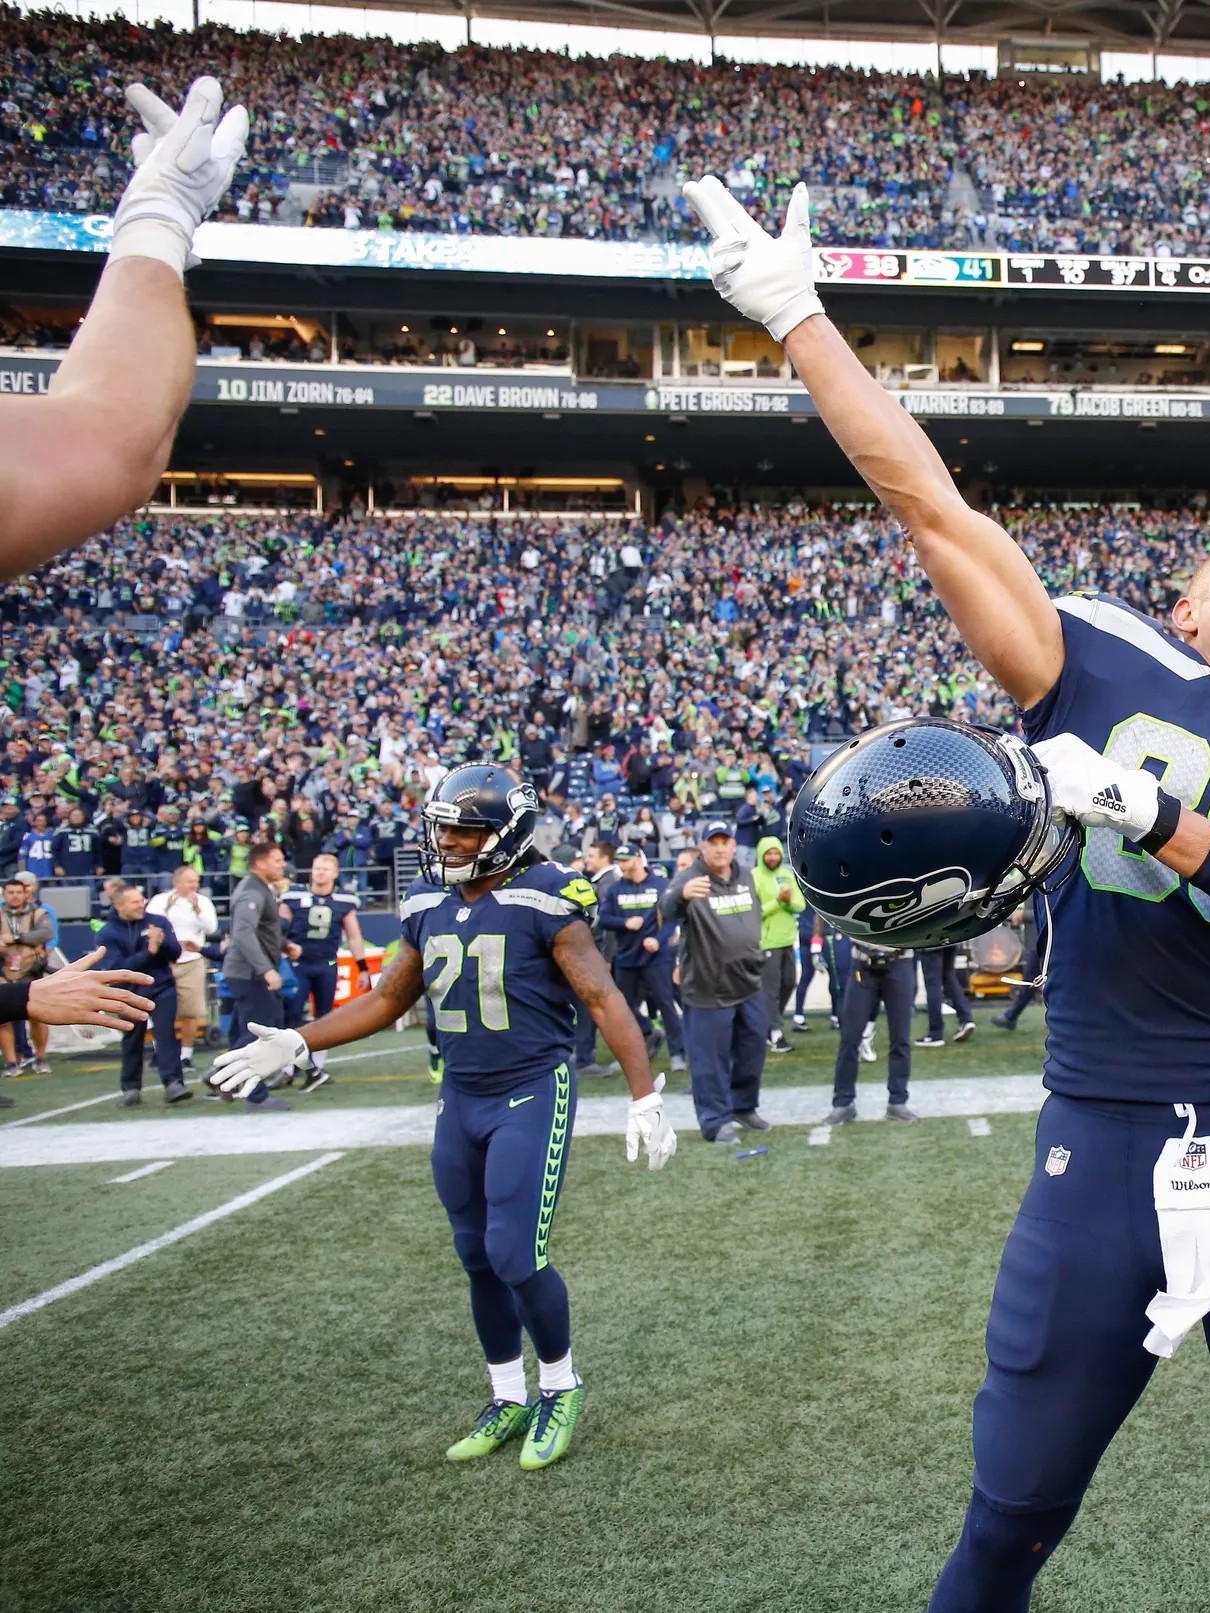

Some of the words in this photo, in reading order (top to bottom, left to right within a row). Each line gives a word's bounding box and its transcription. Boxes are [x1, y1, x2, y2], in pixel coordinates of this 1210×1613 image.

[863, 254, 899, 277] 38
[962, 259, 993, 280] 41
[1022, 267, 1033, 283] 1
[1060, 268, 1085, 284] 10
[217, 379, 248, 400] 10
[250, 380, 284, 402] JIM
[287, 381, 334, 404] ZORN
[423, 384, 453, 406] 22
[454, 385, 496, 407] DAVE
[498, 386, 559, 409] BROWN
[659, 391, 699, 411] PETE
[701, 391, 753, 412] GROSS
[904, 395, 969, 415] WARNER
[1049, 396, 1074, 415] 79
[1074, 398, 1120, 416] JACOB
[1122, 399, 1170, 417] GREEN
[1092, 796, 1127, 813] adidas
[67, 834, 92, 852] 31
[307, 905, 333, 939] 9
[422, 934, 511, 1033] 21
[1182, 1155, 1205, 1168] NFL
